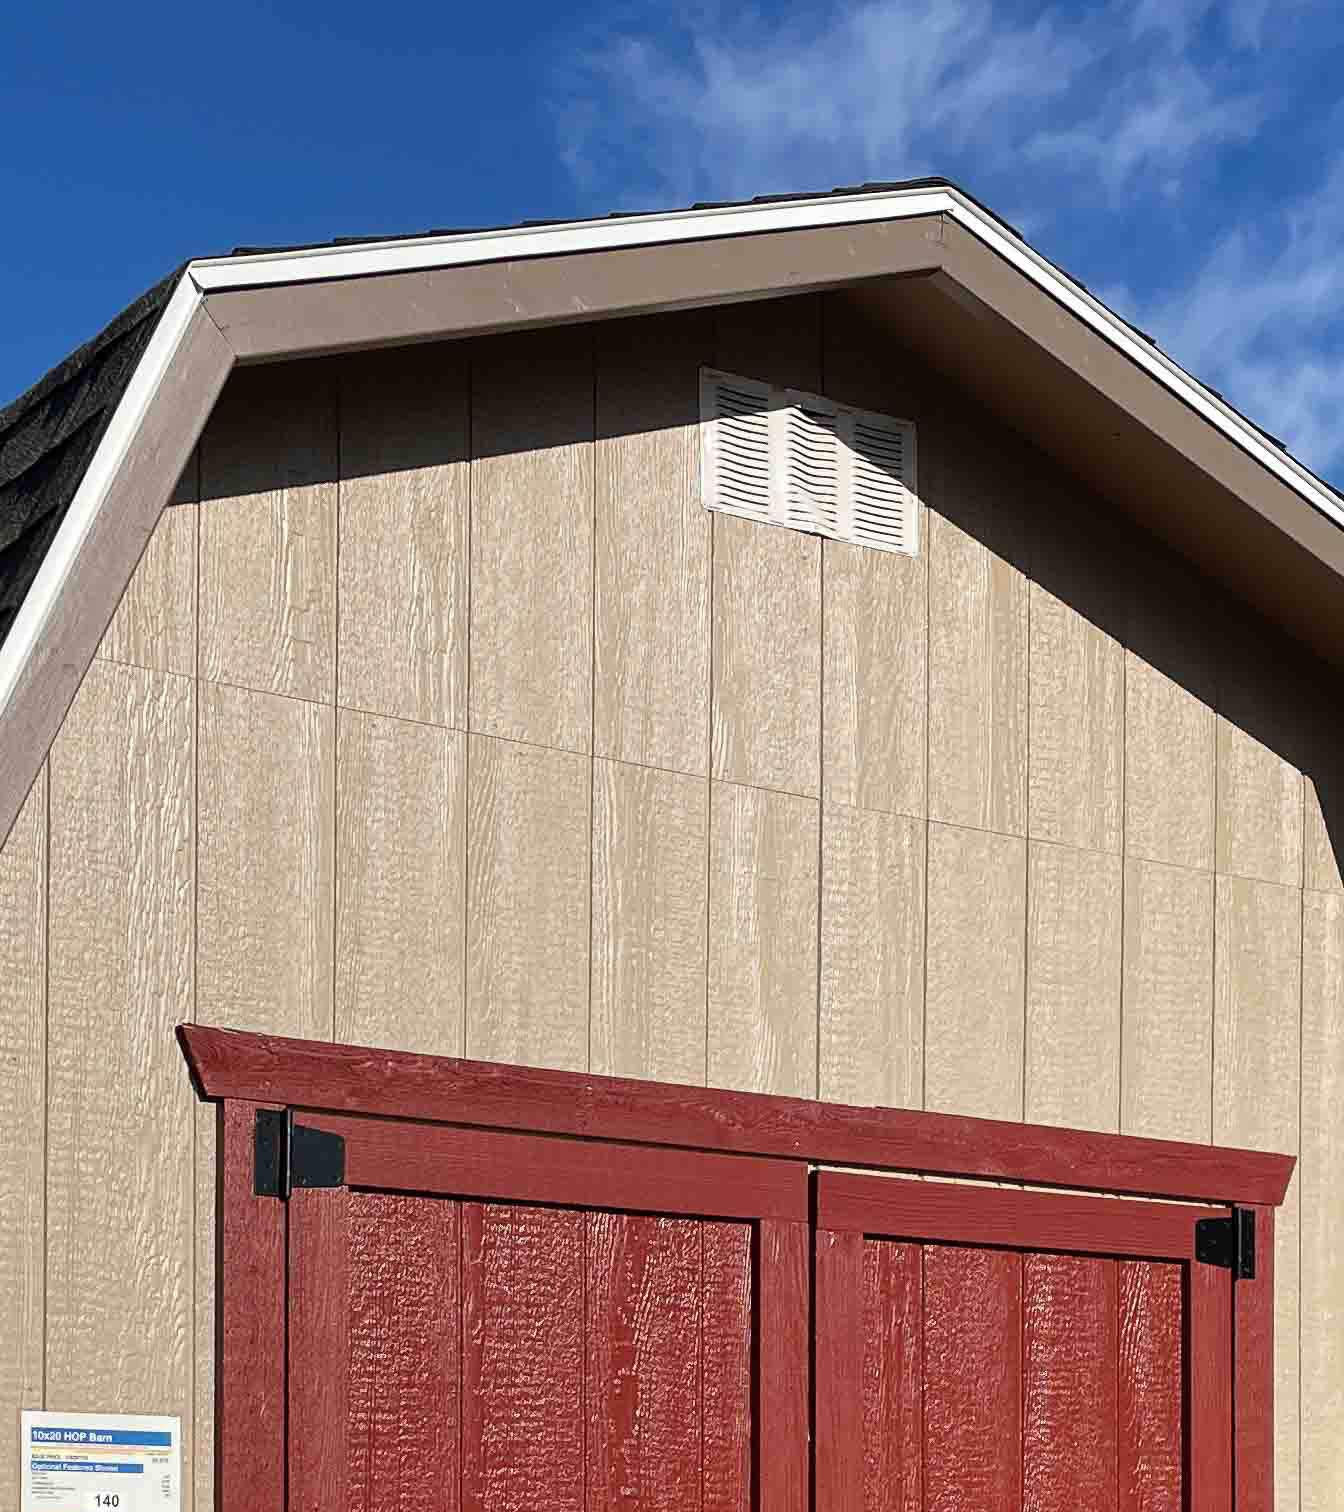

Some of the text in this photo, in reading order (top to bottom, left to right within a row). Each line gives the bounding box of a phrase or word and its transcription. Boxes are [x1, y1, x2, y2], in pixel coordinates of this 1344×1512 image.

[32, 1430, 113, 1443] 10x20 HOP Barn
[95, 1494, 120, 1508] 140
